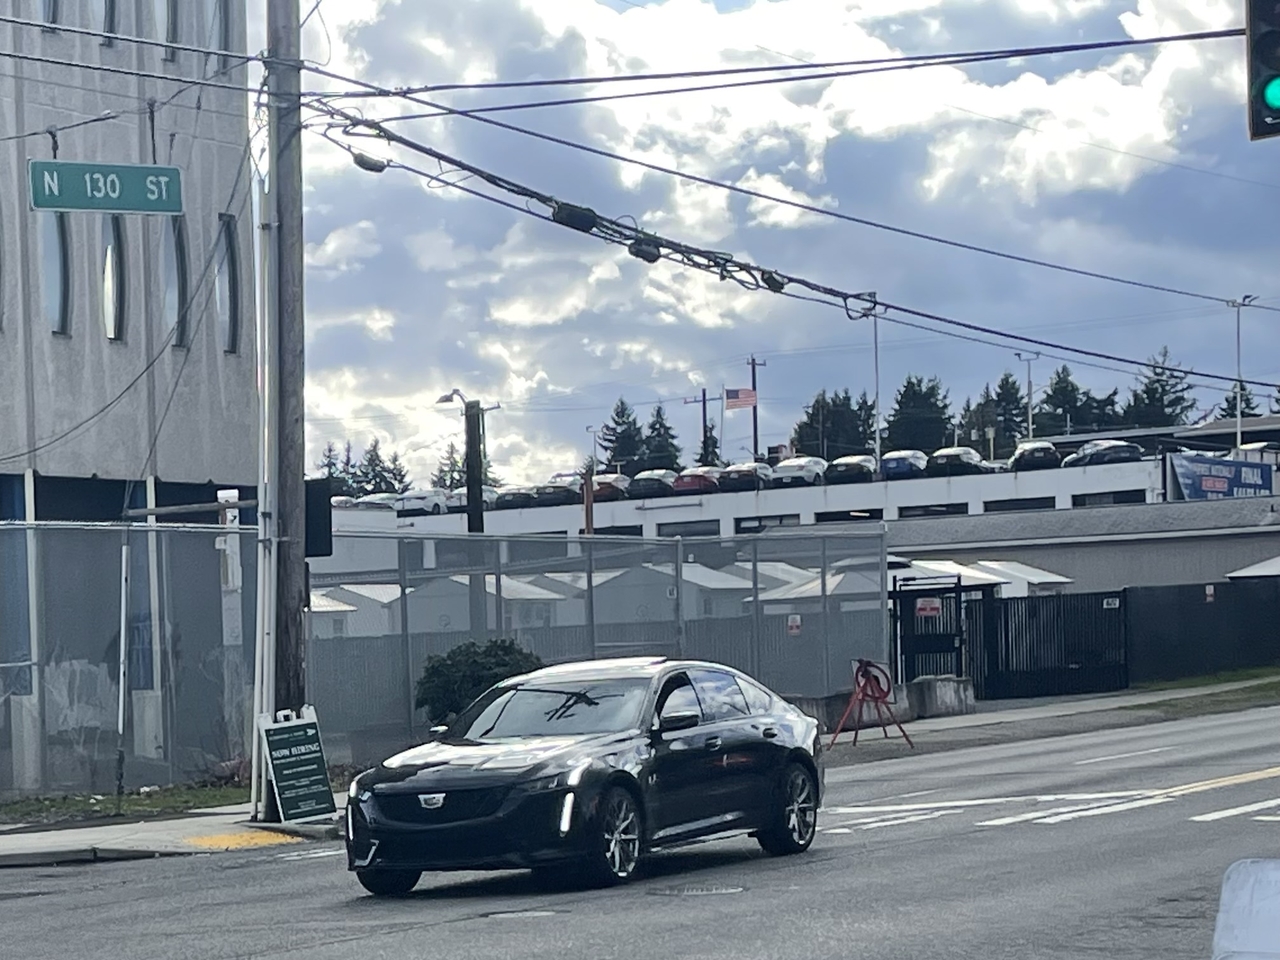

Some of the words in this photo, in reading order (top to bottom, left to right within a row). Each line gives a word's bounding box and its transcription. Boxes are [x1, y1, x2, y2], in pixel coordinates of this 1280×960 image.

[43, 170, 59, 196] N
[84, 172, 120, 199] 130
[146, 175, 170, 200] ST
